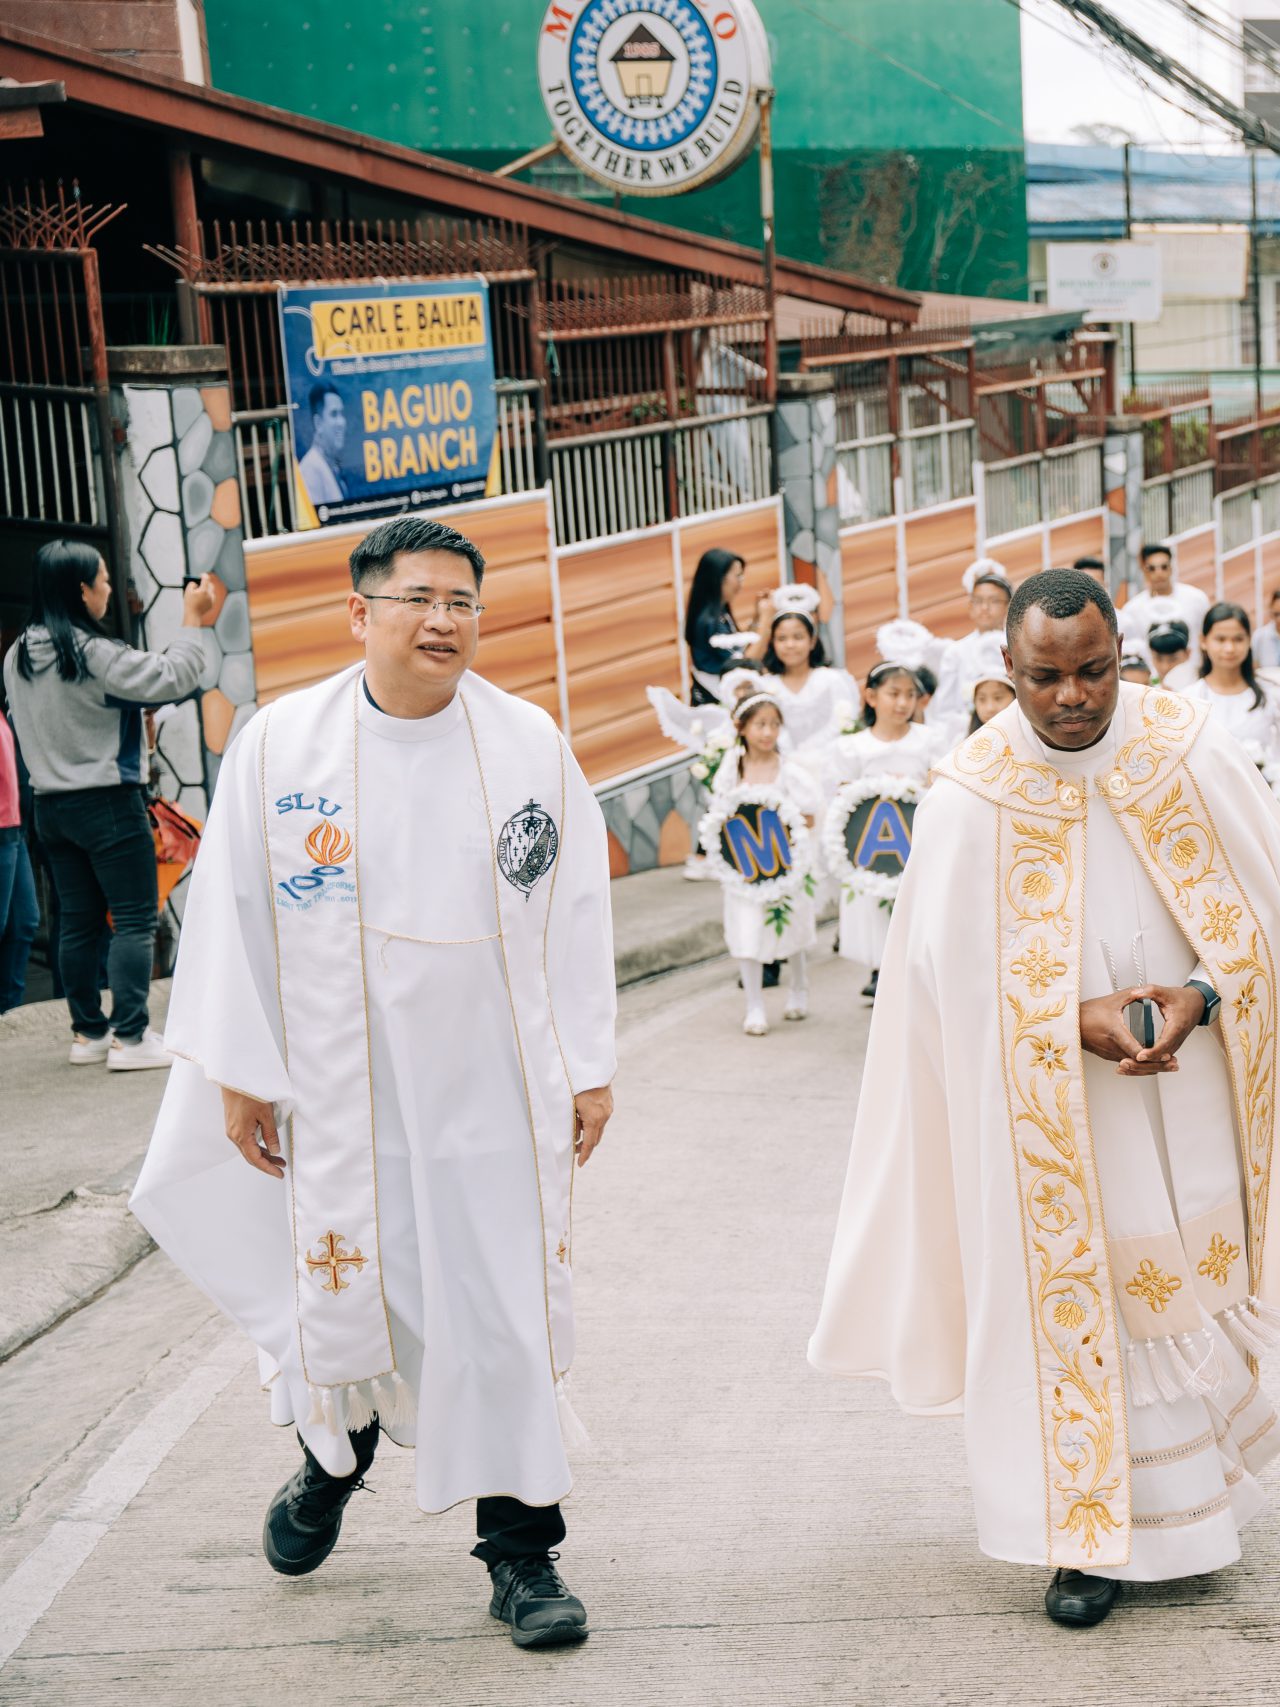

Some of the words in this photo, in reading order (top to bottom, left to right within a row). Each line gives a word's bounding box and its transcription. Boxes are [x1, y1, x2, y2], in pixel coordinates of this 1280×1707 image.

[547, 79, 652, 180] TOGETHER
[659, 148, 697, 178] WE
[695, 79, 743, 158] BUILD
[329, 304, 387, 337] CARL
[394, 303, 411, 332] E.
[416, 299, 480, 330] BALITA
[361, 379, 472, 434] BAGUIO
[362, 425, 477, 483] BRANCH
[275, 792, 342, 817] SLU
[723, 804, 793, 884] M
[854, 798, 914, 869] A
[277, 865, 345, 900] 100
